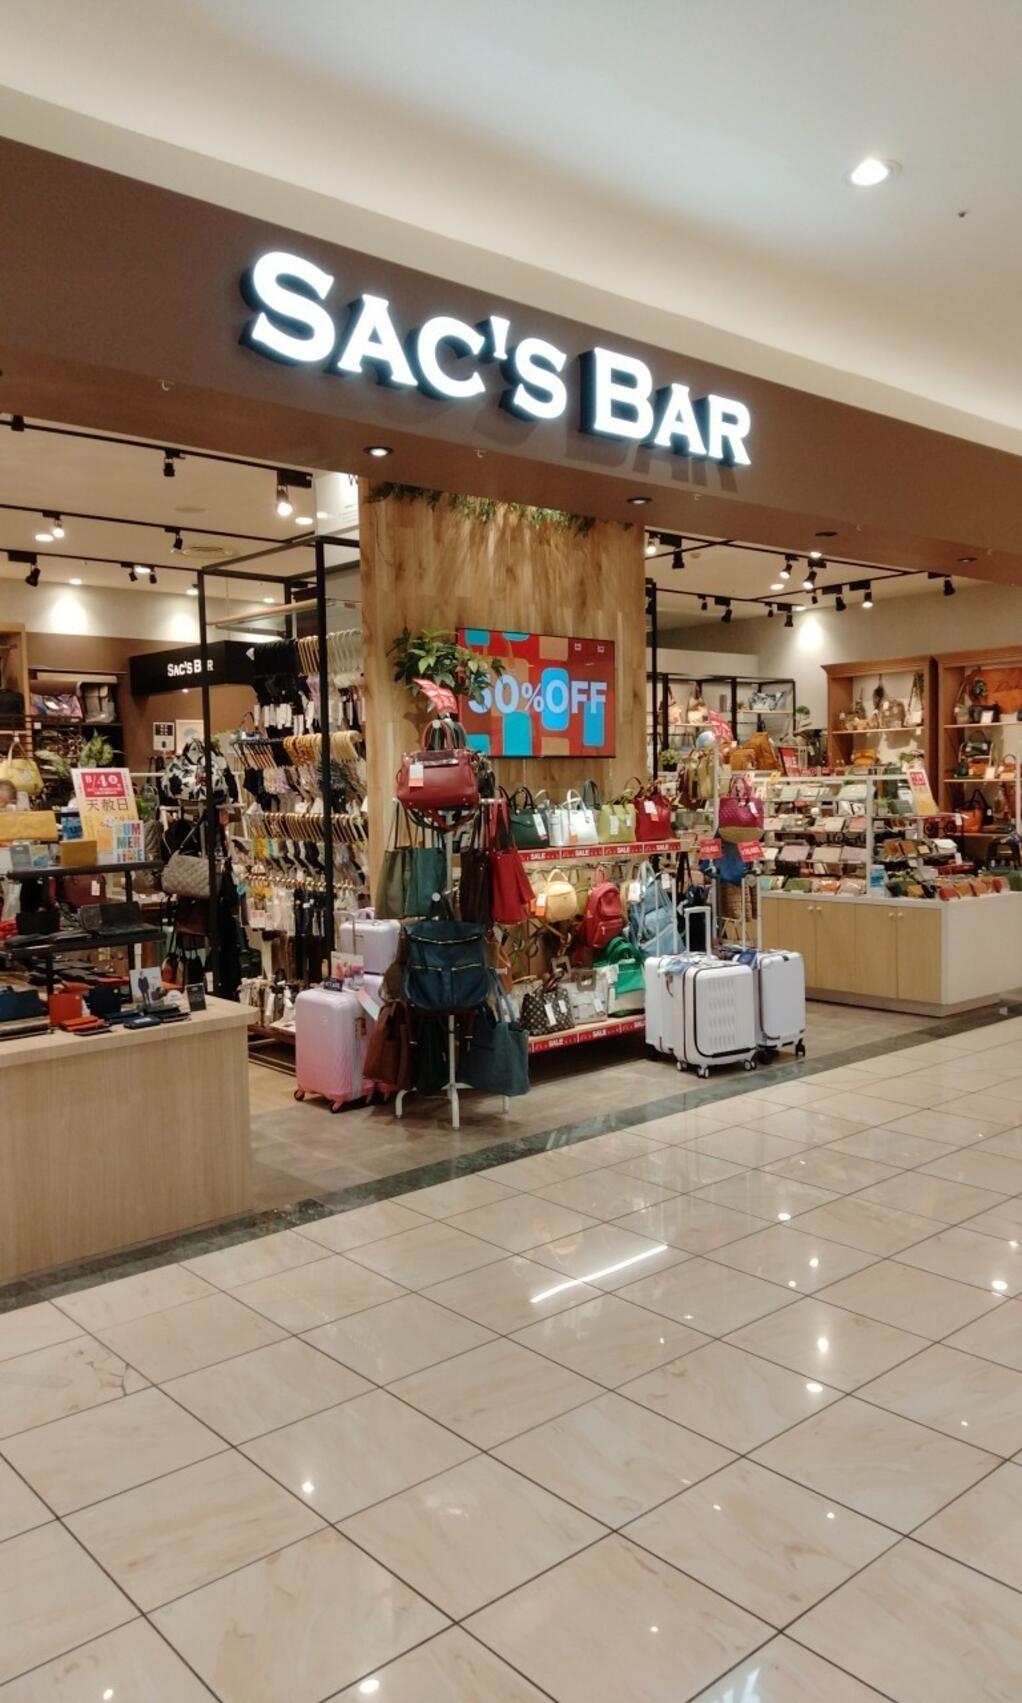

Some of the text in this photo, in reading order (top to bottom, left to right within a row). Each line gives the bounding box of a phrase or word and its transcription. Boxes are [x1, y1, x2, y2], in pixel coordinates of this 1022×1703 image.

[249, 250, 752, 466] SAC'S BAR
[167, 659, 214, 677] SAC'S BR
[575, 849, 590, 857] SALE
[617, 846, 631, 854] SALE
